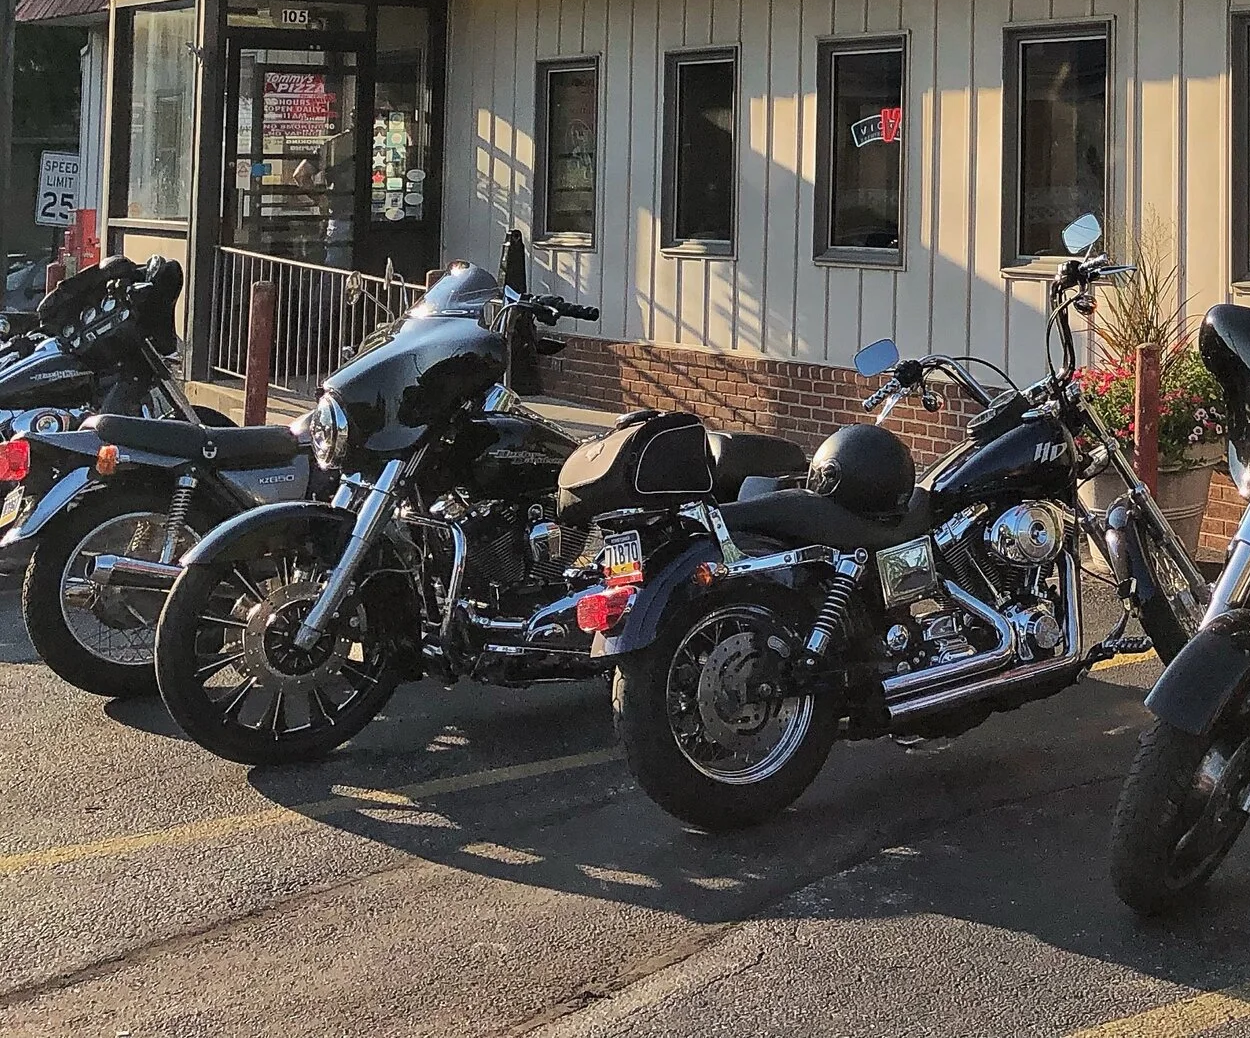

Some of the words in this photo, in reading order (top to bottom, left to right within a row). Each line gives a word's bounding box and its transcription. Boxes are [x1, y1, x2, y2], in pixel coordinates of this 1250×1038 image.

[283, 10, 307, 23] 105
[266, 72, 314, 85] Tommy's
[276, 82, 325, 93] PIZZA
[44, 160, 79, 174] SPEED
[46, 175, 74, 188] LIMIT
[41, 191, 74, 220] 25
[1033, 441, 1068, 463] HD
